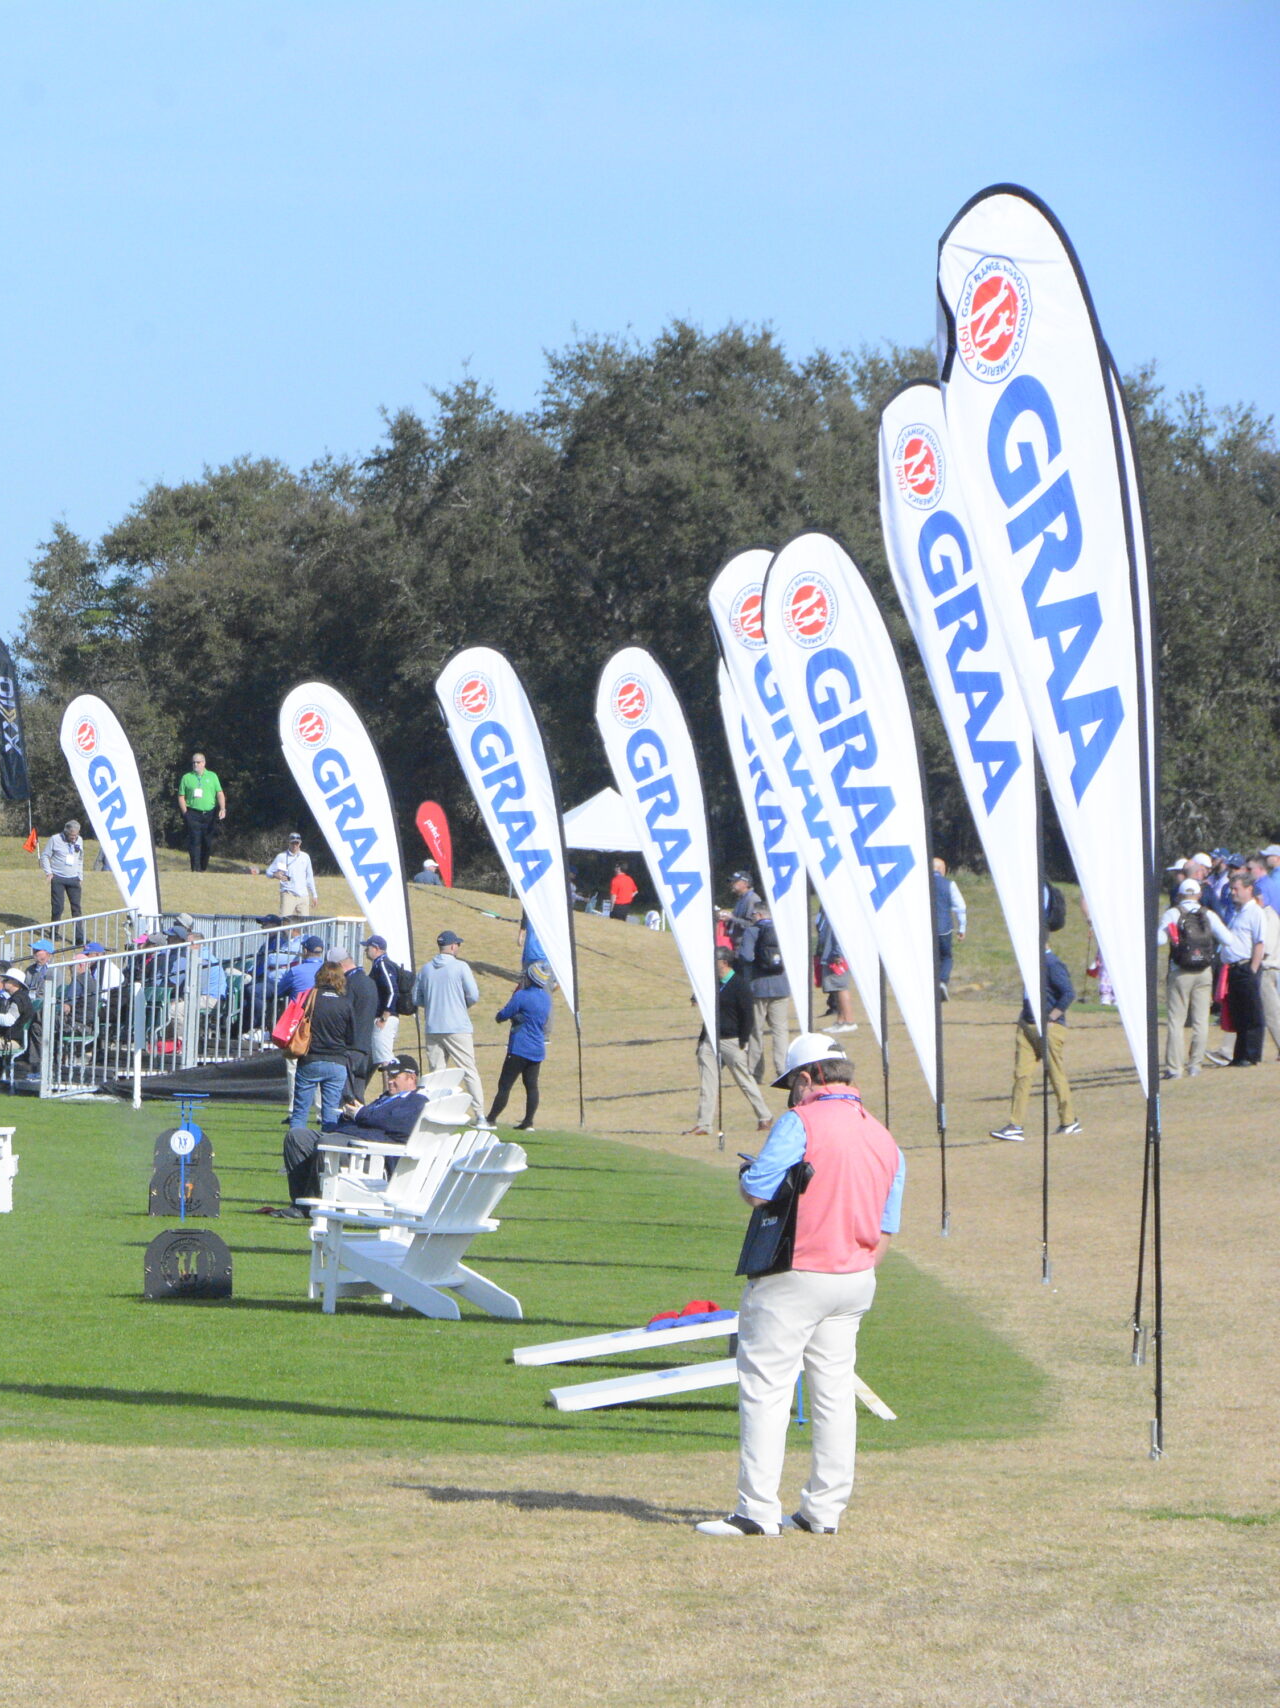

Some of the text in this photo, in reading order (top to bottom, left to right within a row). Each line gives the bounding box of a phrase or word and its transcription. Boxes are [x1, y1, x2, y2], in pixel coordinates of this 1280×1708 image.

[918, 510, 1022, 817] GRAA
[987, 374, 1125, 805] GRAA
[88, 755, 147, 896] GRAA
[312, 748, 393, 903] GRAA
[470, 720, 553, 893] GRAA
[626, 728, 703, 919] GRAA
[806, 648, 916, 912] GRAA
